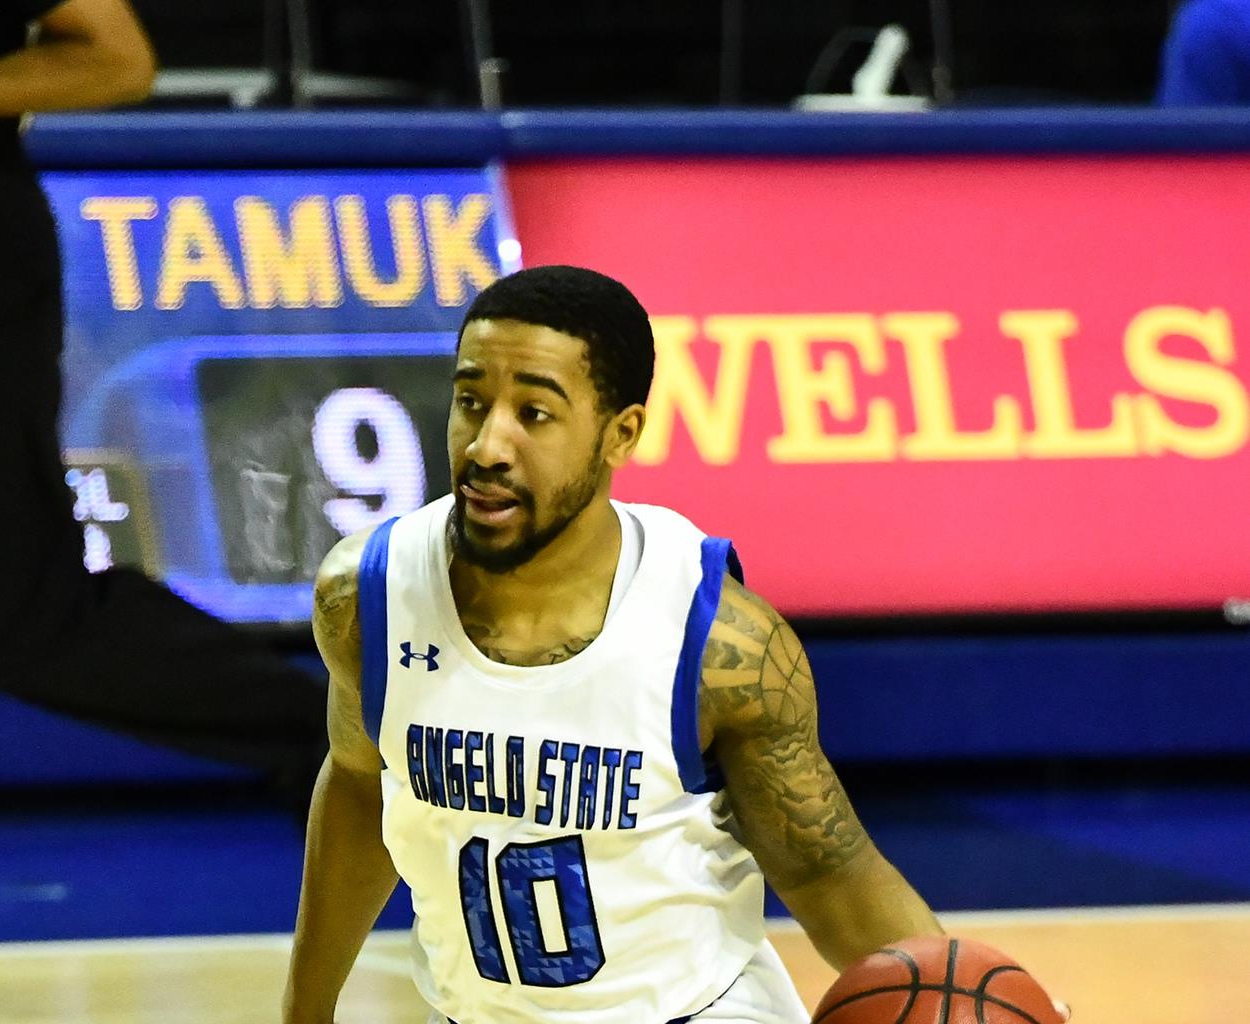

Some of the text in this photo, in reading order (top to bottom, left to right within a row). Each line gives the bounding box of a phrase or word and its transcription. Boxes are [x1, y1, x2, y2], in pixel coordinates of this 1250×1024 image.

[80, 194, 507, 311] TAMUK
[631, 306, 1250, 465] WELLS
[312, 387, 428, 538] 9
[406, 724, 644, 830] ANGELO STATE
[458, 833, 606, 988] 10
